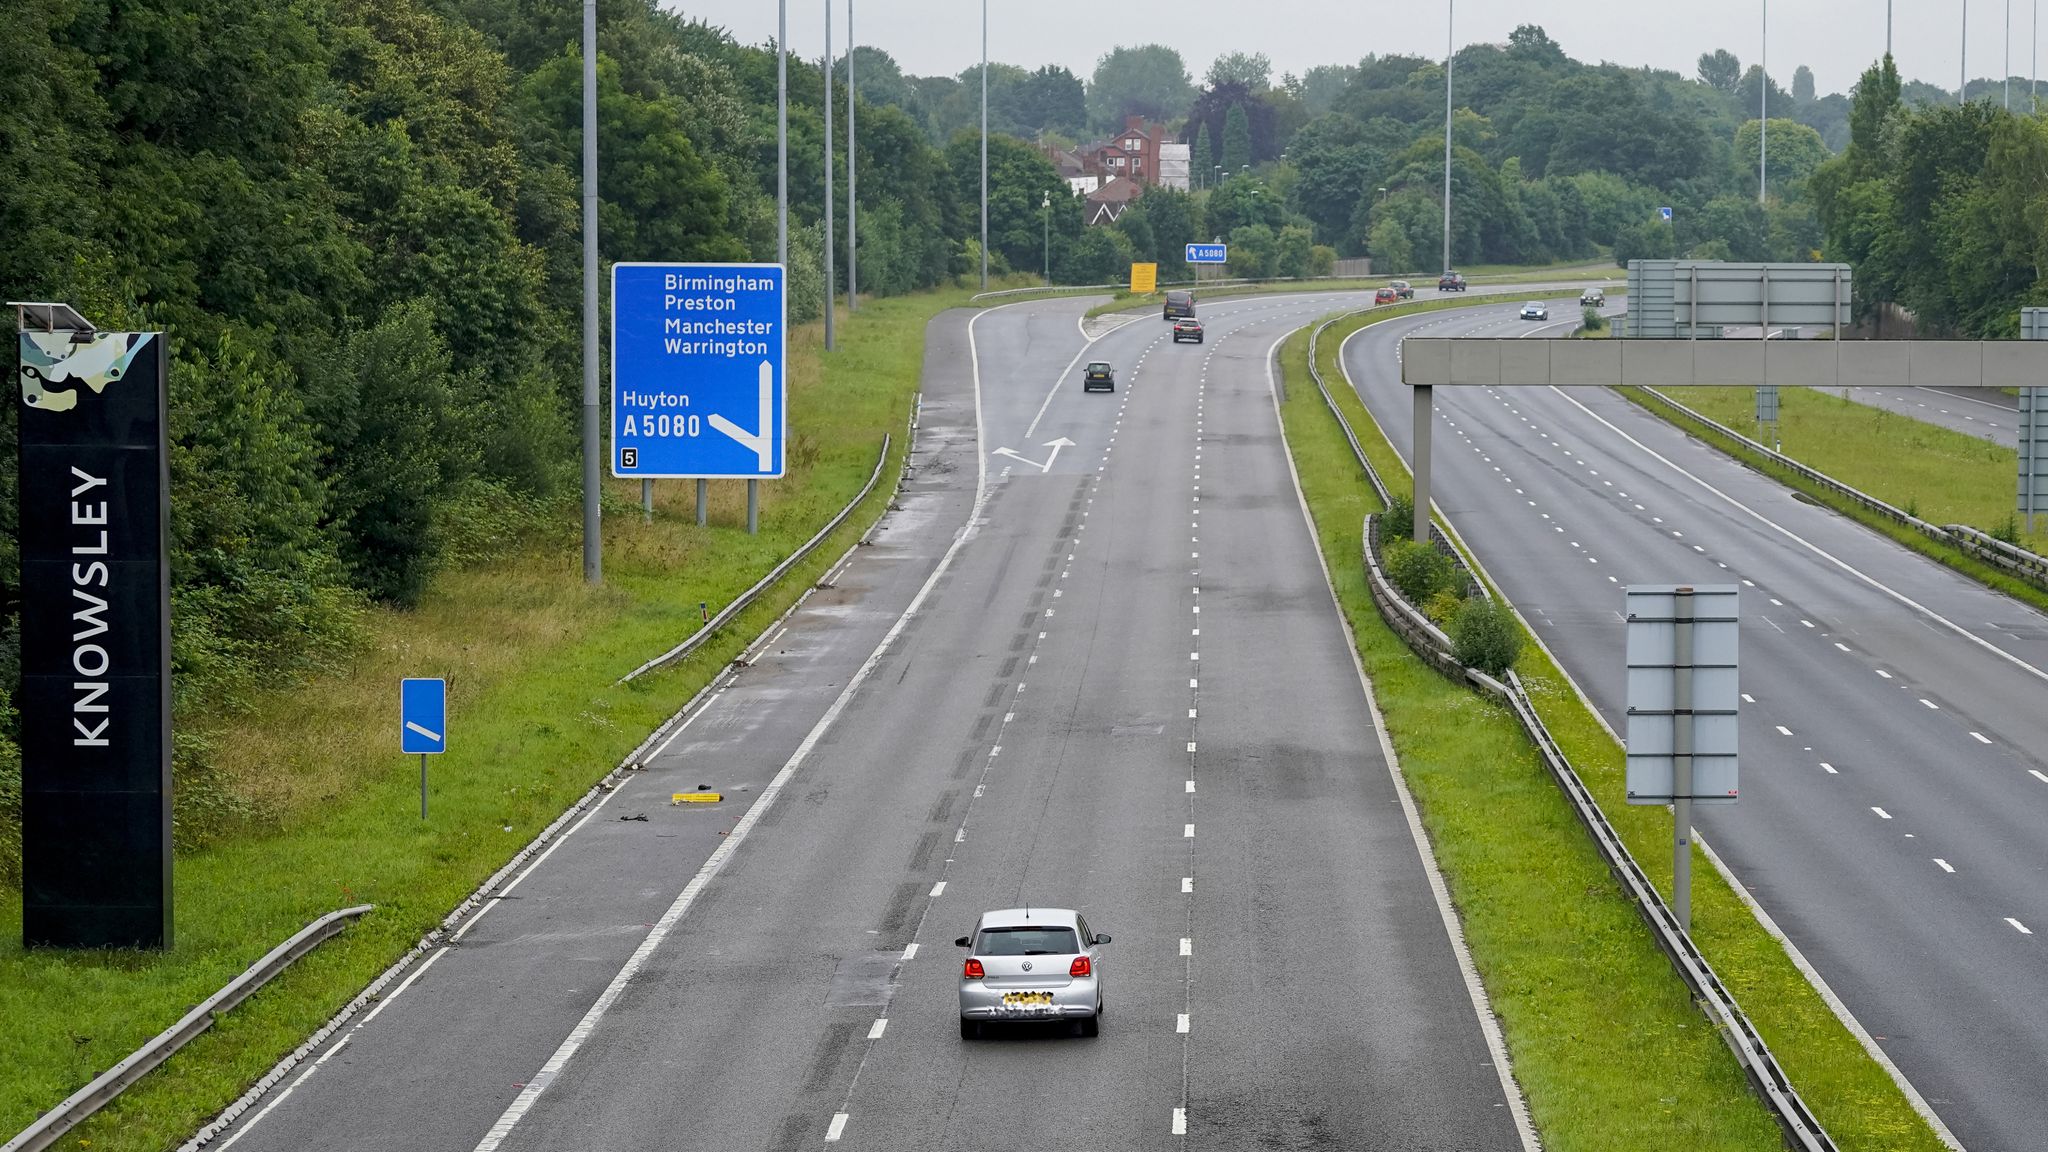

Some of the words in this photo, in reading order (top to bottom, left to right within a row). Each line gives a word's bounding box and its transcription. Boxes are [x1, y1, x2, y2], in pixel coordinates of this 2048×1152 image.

[665, 274, 774, 293] Birmingham
[665, 294, 735, 311] Preston
[665, 318, 772, 334] Manchester
[665, 338, 767, 357] Warrington
[623, 391, 689, 409] Huyton
[625, 452, 634, 465] 5
[71, 466, 109, 747] KNOWSLEY
